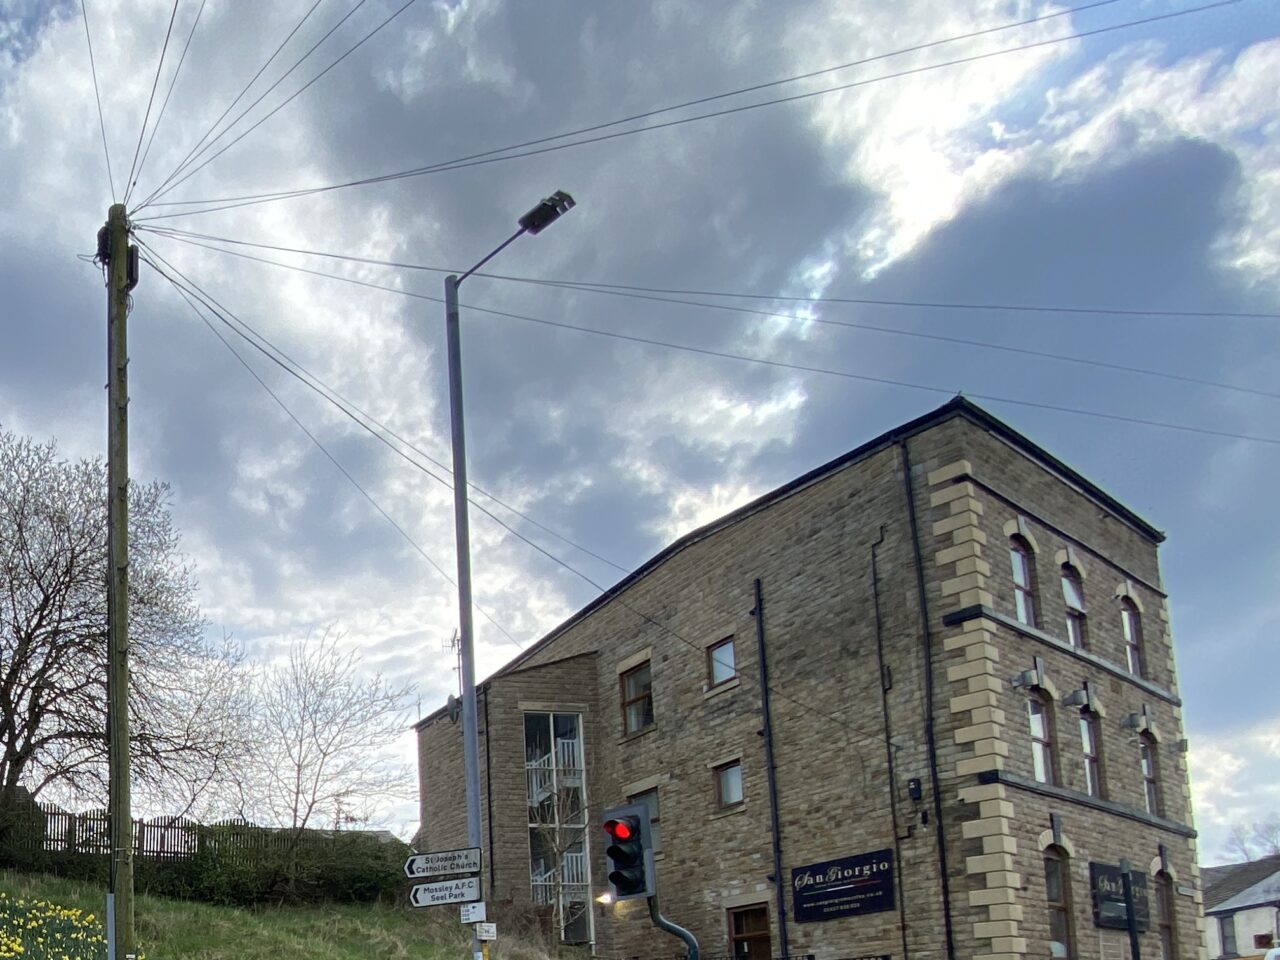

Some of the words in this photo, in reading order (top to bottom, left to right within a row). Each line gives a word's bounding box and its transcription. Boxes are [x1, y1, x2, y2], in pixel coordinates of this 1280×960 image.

[425, 857, 433, 865] St
[436, 853, 468, 863] Joseph's
[416, 864, 447, 874] Catholic
[450, 861, 478, 871] Church
[423, 884, 453, 894] Mossley
[431, 893, 447, 902] Seel
[449, 891, 465, 900] Park
